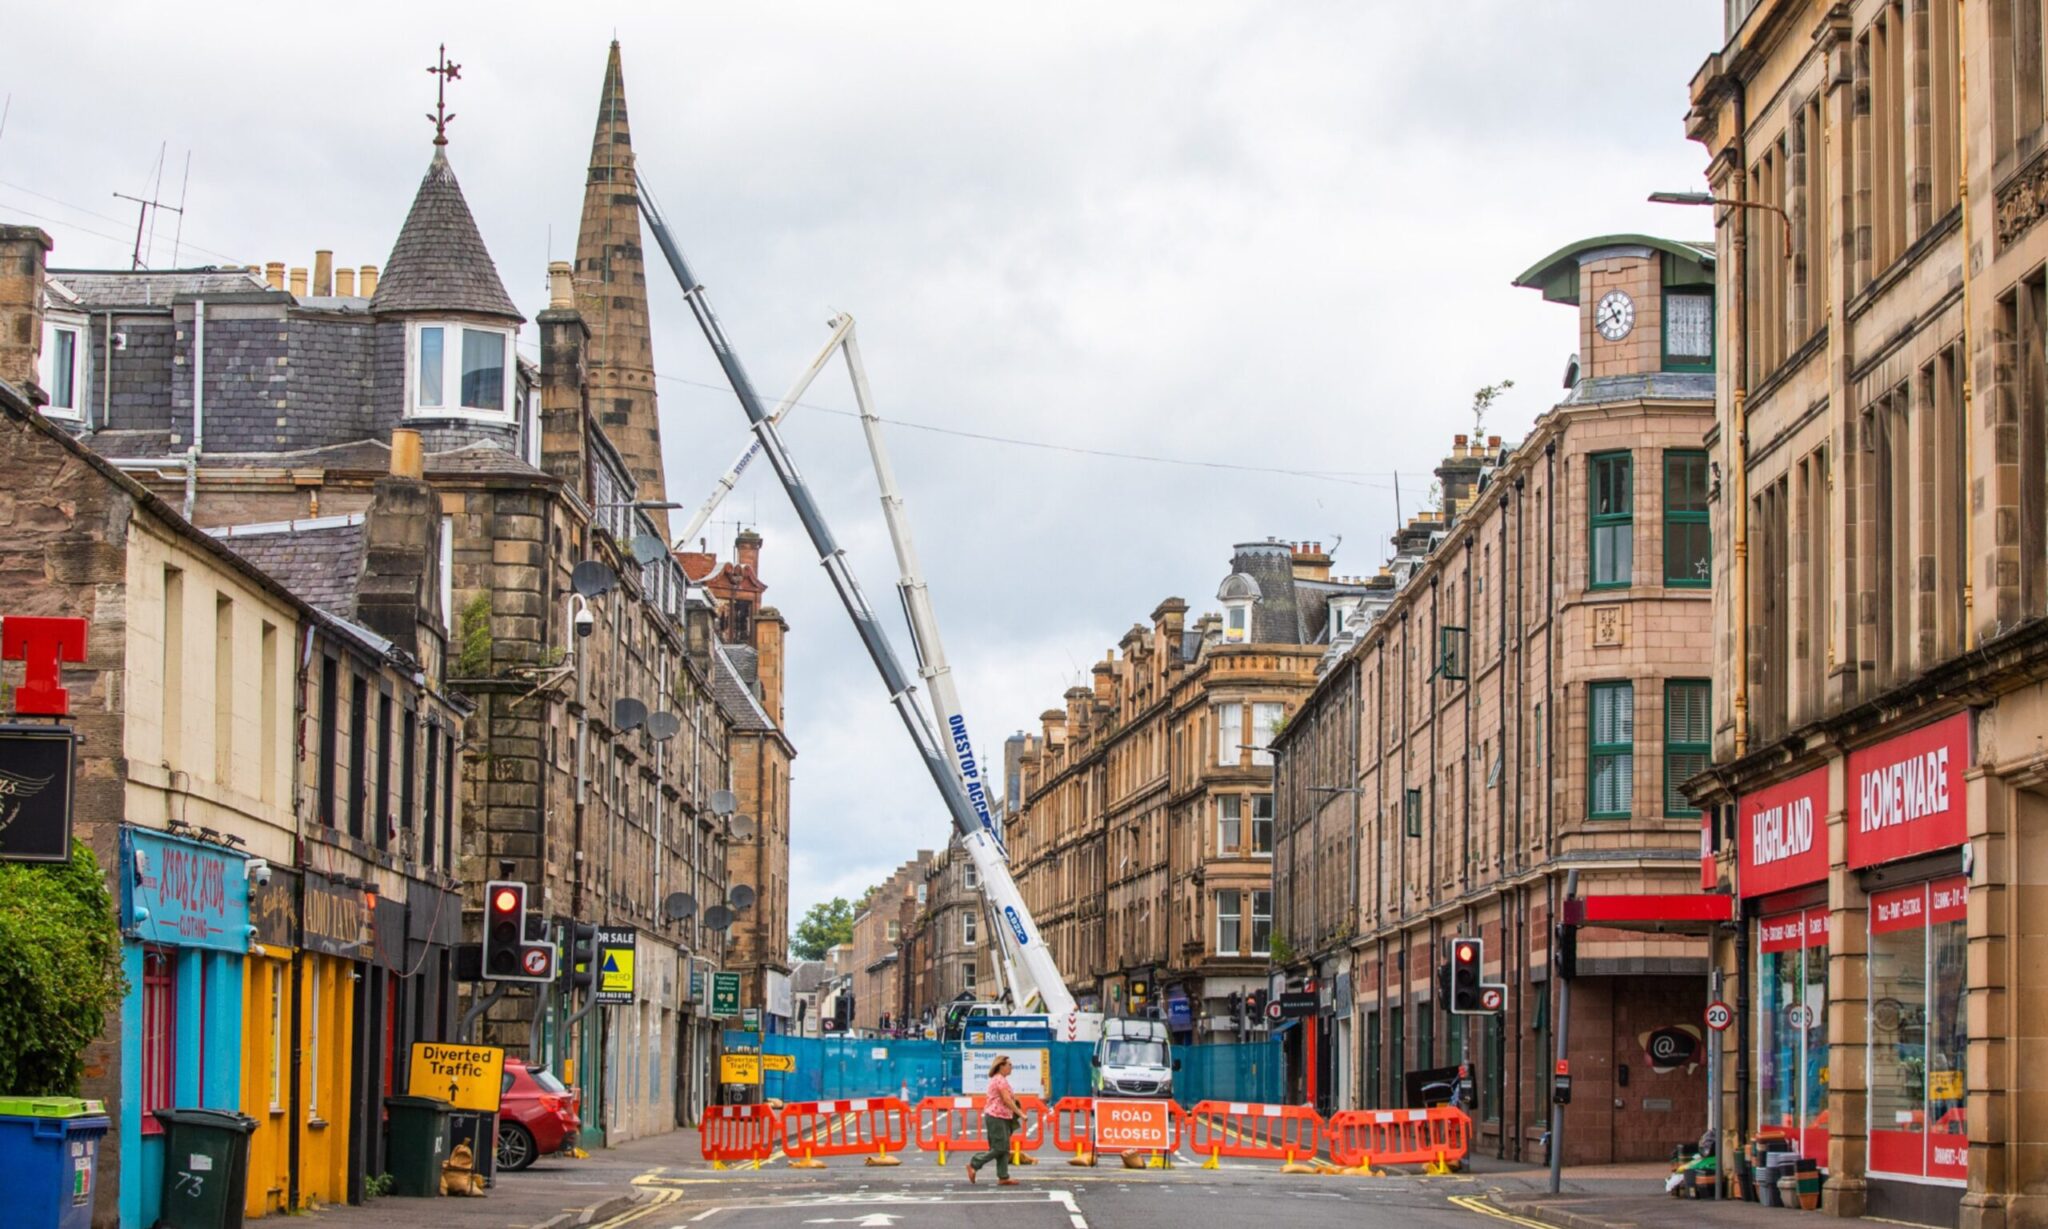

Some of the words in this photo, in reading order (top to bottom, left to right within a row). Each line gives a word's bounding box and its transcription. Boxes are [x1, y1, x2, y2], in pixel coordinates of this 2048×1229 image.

[948, 714, 978, 779] ONESTOP
[1861, 745, 1949, 834] HOMEWARE
[1753, 796, 1813, 866] HIGHLAND
[610, 932, 634, 944] SALE
[1708, 1011, 1727, 1022] 20
[424, 1046, 491, 1063] Diverted
[1654, 1035, 1675, 1058] @
[726, 1055, 758, 1063] Diverted
[730, 1062, 754, 1070] Traffic
[430, 1061, 482, 1078] Traffic
[1112, 1109, 1152, 1123] ROAD
[1103, 1127, 1161, 1140] CLOSED
[174, 1171, 204, 1197] 73
